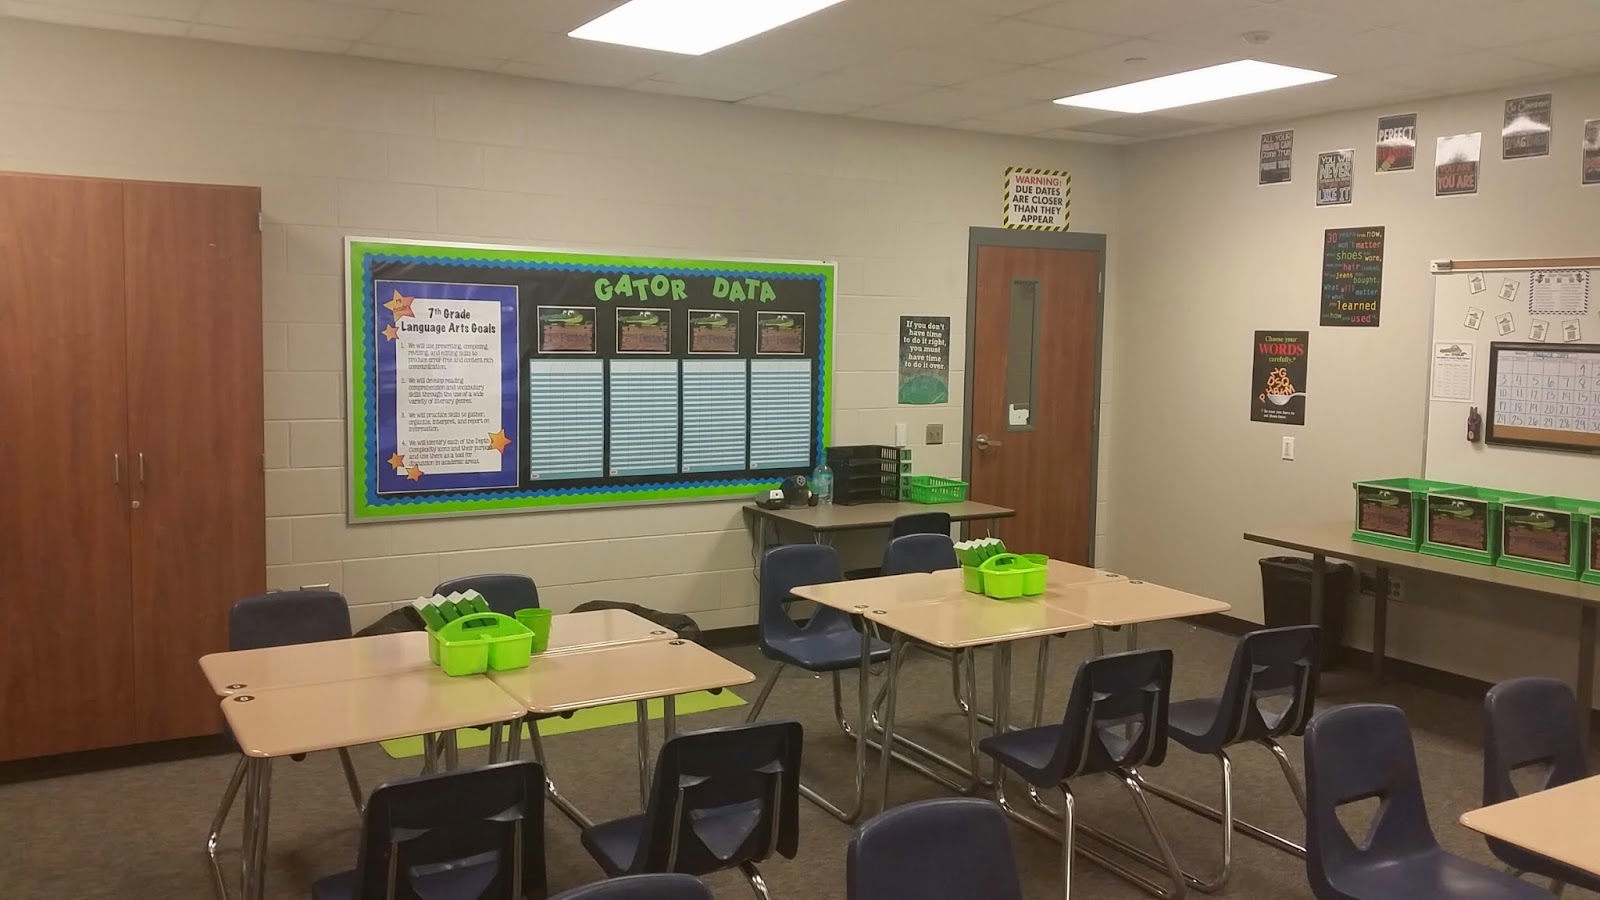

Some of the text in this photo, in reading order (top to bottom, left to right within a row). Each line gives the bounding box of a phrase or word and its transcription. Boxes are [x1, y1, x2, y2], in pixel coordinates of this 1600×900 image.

[1263, 133, 1291, 143] ALL YOUR
[1379, 126, 1414, 142] PERFECT
[1321, 153, 1351, 165] YOU WI
[1320, 162, 1351, 179] NEVER
[1015, 175, 1062, 187] WARNING:
[1438, 175, 1475, 190] YOU ARE
[1016, 185, 1061, 196] DUE DATES
[1319, 187, 1351, 202] LIKE IT
[1012, 194, 1063, 206] ARE CLOSER
[1013, 204, 1061, 215] THAN THEY
[1020, 214, 1054, 224] APPEAR
[1327, 232, 1338, 244] 30
[1355, 241, 1381, 249] matter
[1336, 250, 1363, 261] shoes
[1343, 262, 1360, 271] hair
[1335, 272, 1354, 280] jeans
[594, 274, 777, 303] GATOR DATA
[1337, 300, 1377, 311] learned
[428, 307, 471, 320] 7th Grade
[1350, 314, 1371, 323] used
[401, 320, 496, 335] Language Arts Goals
[906, 320, 945, 331] If you don't
[909, 328, 942, 338] have time
[911, 336, 921, 344] do
[922, 337, 927, 345] it
[928, 337, 947, 347] right,
[1284, 336, 1298, 344] your
[909, 345, 923, 353] you
[1258, 343, 1304, 356] WORDS
[908, 352, 941, 362] have time
[905, 360, 912, 368] to
[923, 361, 928, 369] it
[929, 362, 946, 370] over.
[1501, 374, 1507, 385] 3
[1516, 375, 1522, 385] 4
[1532, 376, 1539, 385] 5
[1547, 376, 1554, 388] 6
[1499, 388, 1507, 397] 10
[1516, 388, 1523, 398] 11
[1530, 389, 1539, 399] 12
[1546, 391, 1555, 400] 13
[1562, 391, 1571, 401] 14
[1578, 391, 1588, 402] 15
[1499, 401, 1586, 416] 17 18 19 20 21 22
[1496, 413, 1506, 424] 24
[1511, 414, 1523, 425] 25
[1528, 416, 1539, 426] 26
[1544, 417, 1553, 427] 27
[1559, 418, 1570, 428] 28
[1575, 419, 1586, 430] 29
[903, 463, 909, 473] 2
[903, 476, 910, 486] 3
